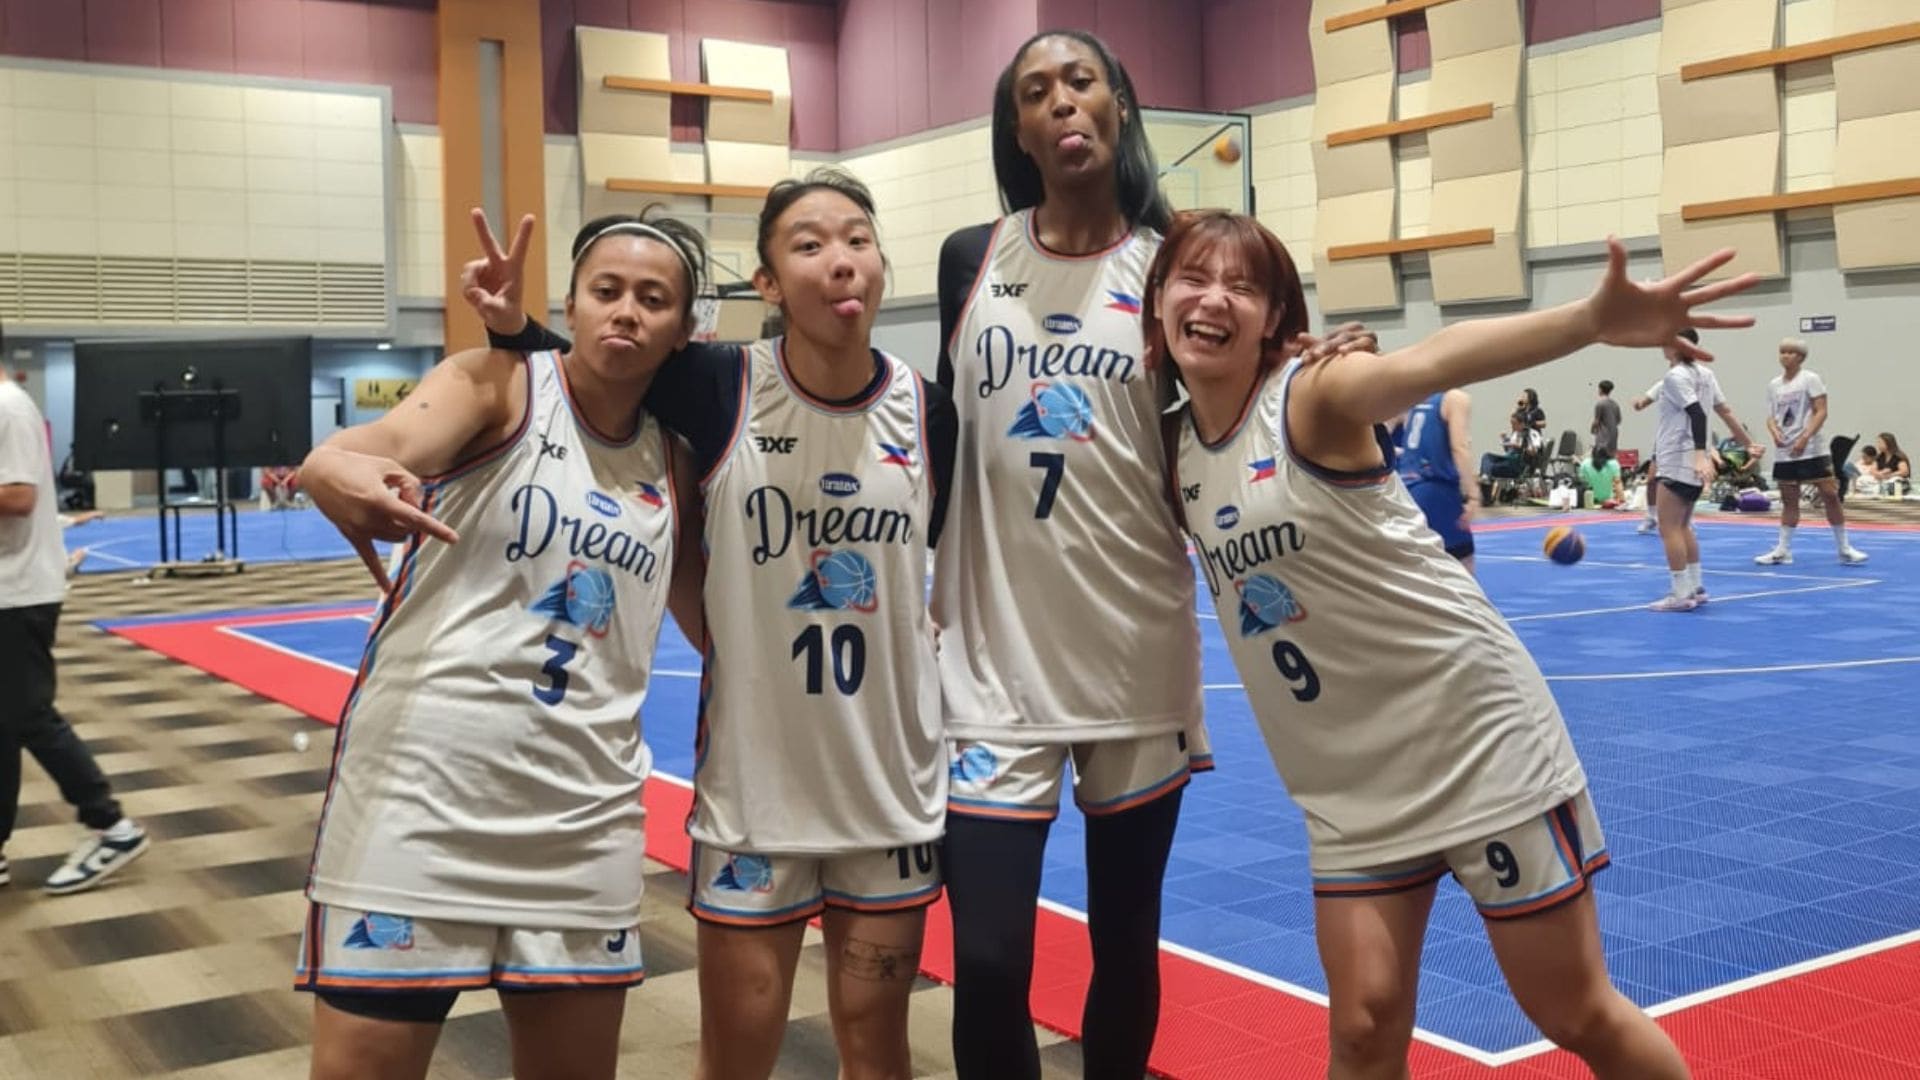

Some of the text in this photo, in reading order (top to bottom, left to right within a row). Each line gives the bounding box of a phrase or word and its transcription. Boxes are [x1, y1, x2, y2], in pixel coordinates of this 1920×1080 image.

[976, 325, 1136, 398] Dream
[1029, 452, 1065, 519] 7
[506, 484, 657, 582] Dream
[745, 485, 914, 565] Dream
[532, 633, 577, 706] 3
[791, 623, 867, 696] 10
[1272, 640, 1321, 702] 9
[1486, 841, 1520, 888] 9
